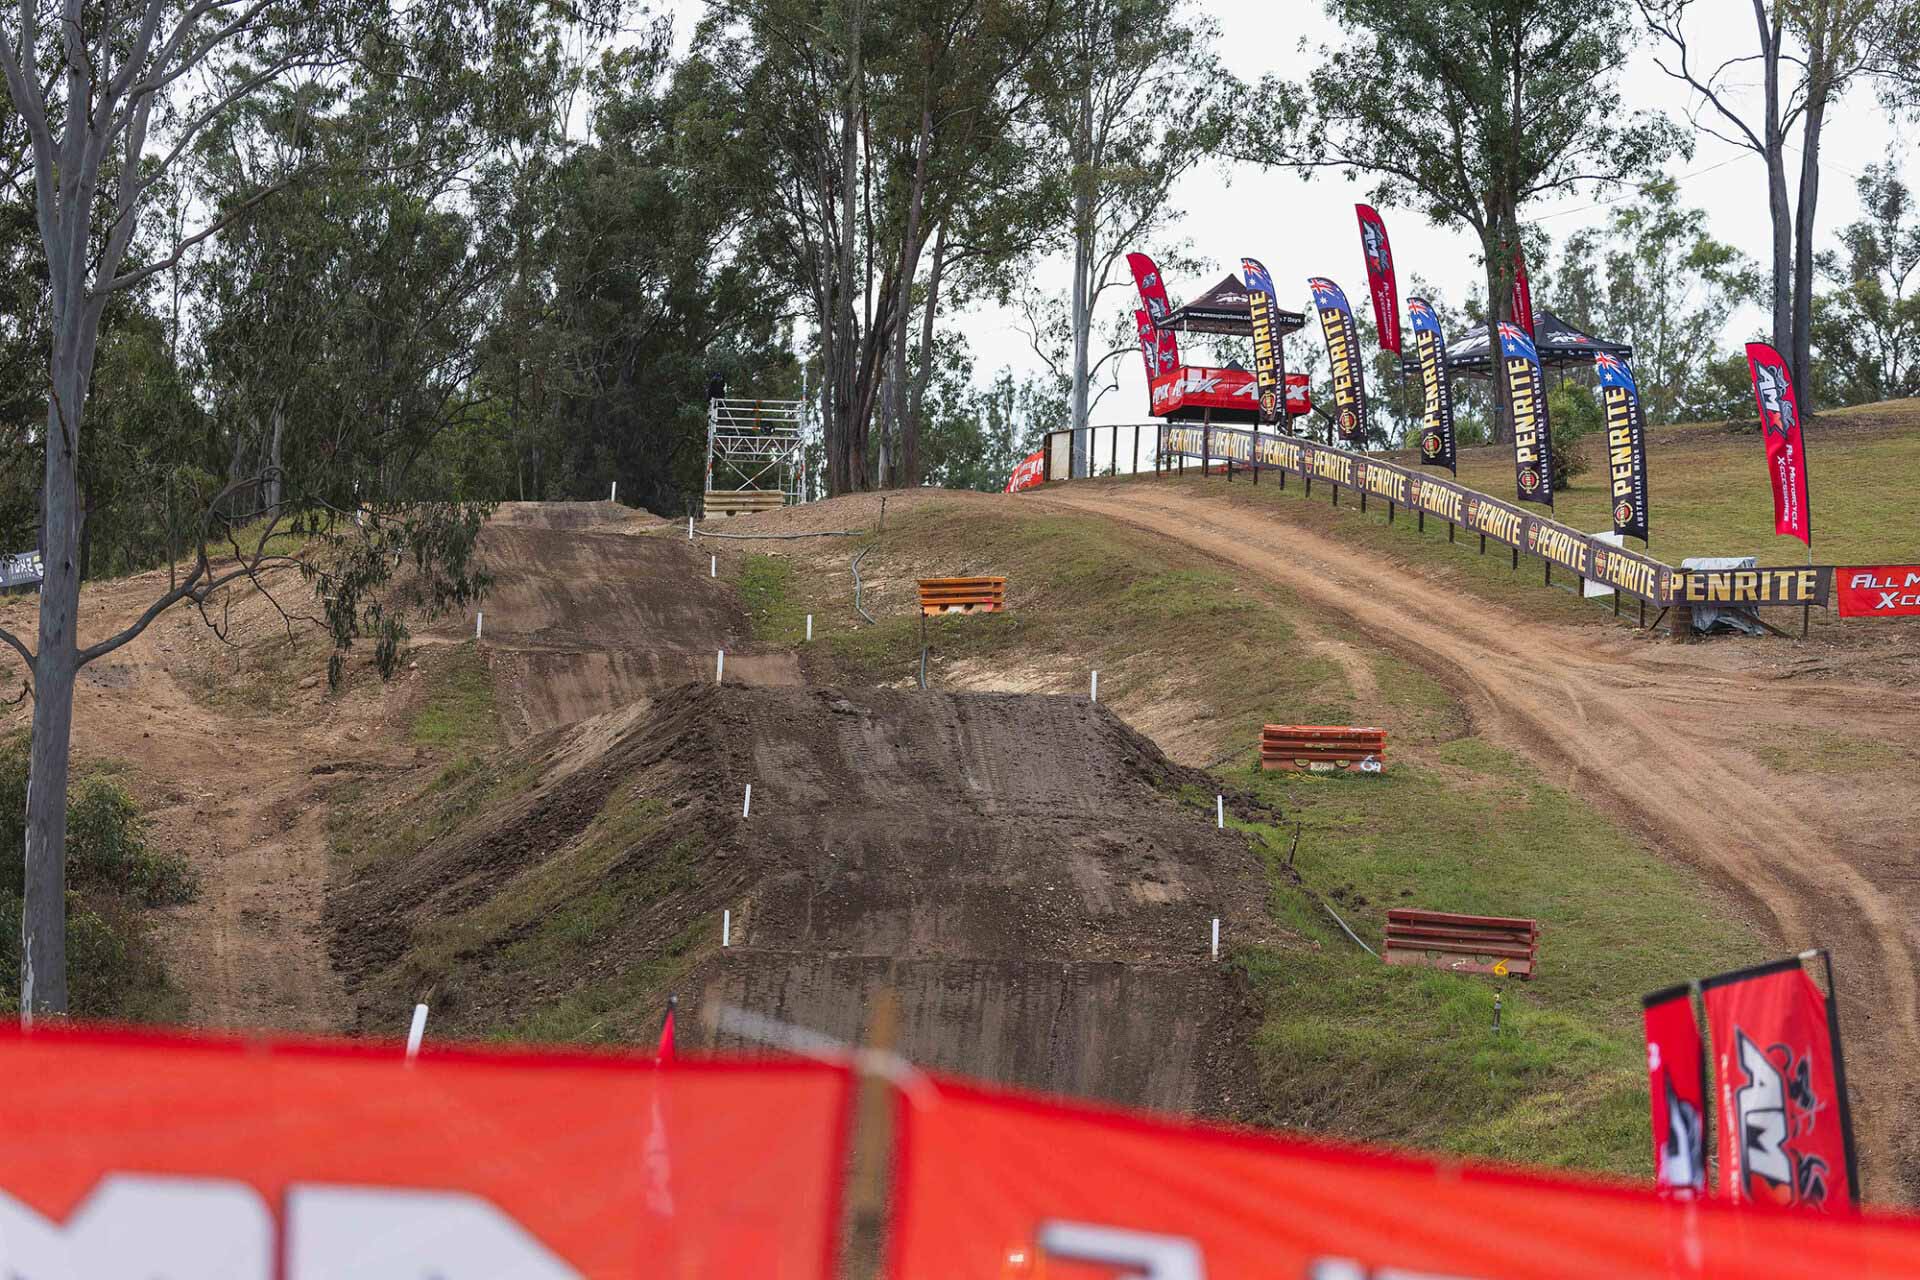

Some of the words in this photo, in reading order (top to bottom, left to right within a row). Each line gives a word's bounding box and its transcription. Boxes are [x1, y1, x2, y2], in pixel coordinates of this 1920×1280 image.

[1250, 291, 1276, 387] PENRITE
[1321, 308, 1353, 407] PENRITE
[1232, 380, 1310, 401] AX
[1418, 330, 1440, 429] PENRITE
[1507, 358, 1537, 464] PENRITE
[1168, 428, 1204, 454] PENRITE
[1214, 431, 1251, 462] PENRITE
[1263, 438, 1300, 471] PENRITE
[1606, 387, 1632, 497] PENRITE
[1313, 450, 1352, 486] PENRITE
[1365, 464, 1407, 502] PENRITE
[1418, 480, 1464, 522] PENRITE
[1475, 500, 1523, 546] PENRITE
[1536, 525, 1588, 572] PENRITE
[1605, 551, 1656, 600] PENRITE
[1669, 570, 1817, 601] PENRITE
[1493, 958, 1509, 977] 6
